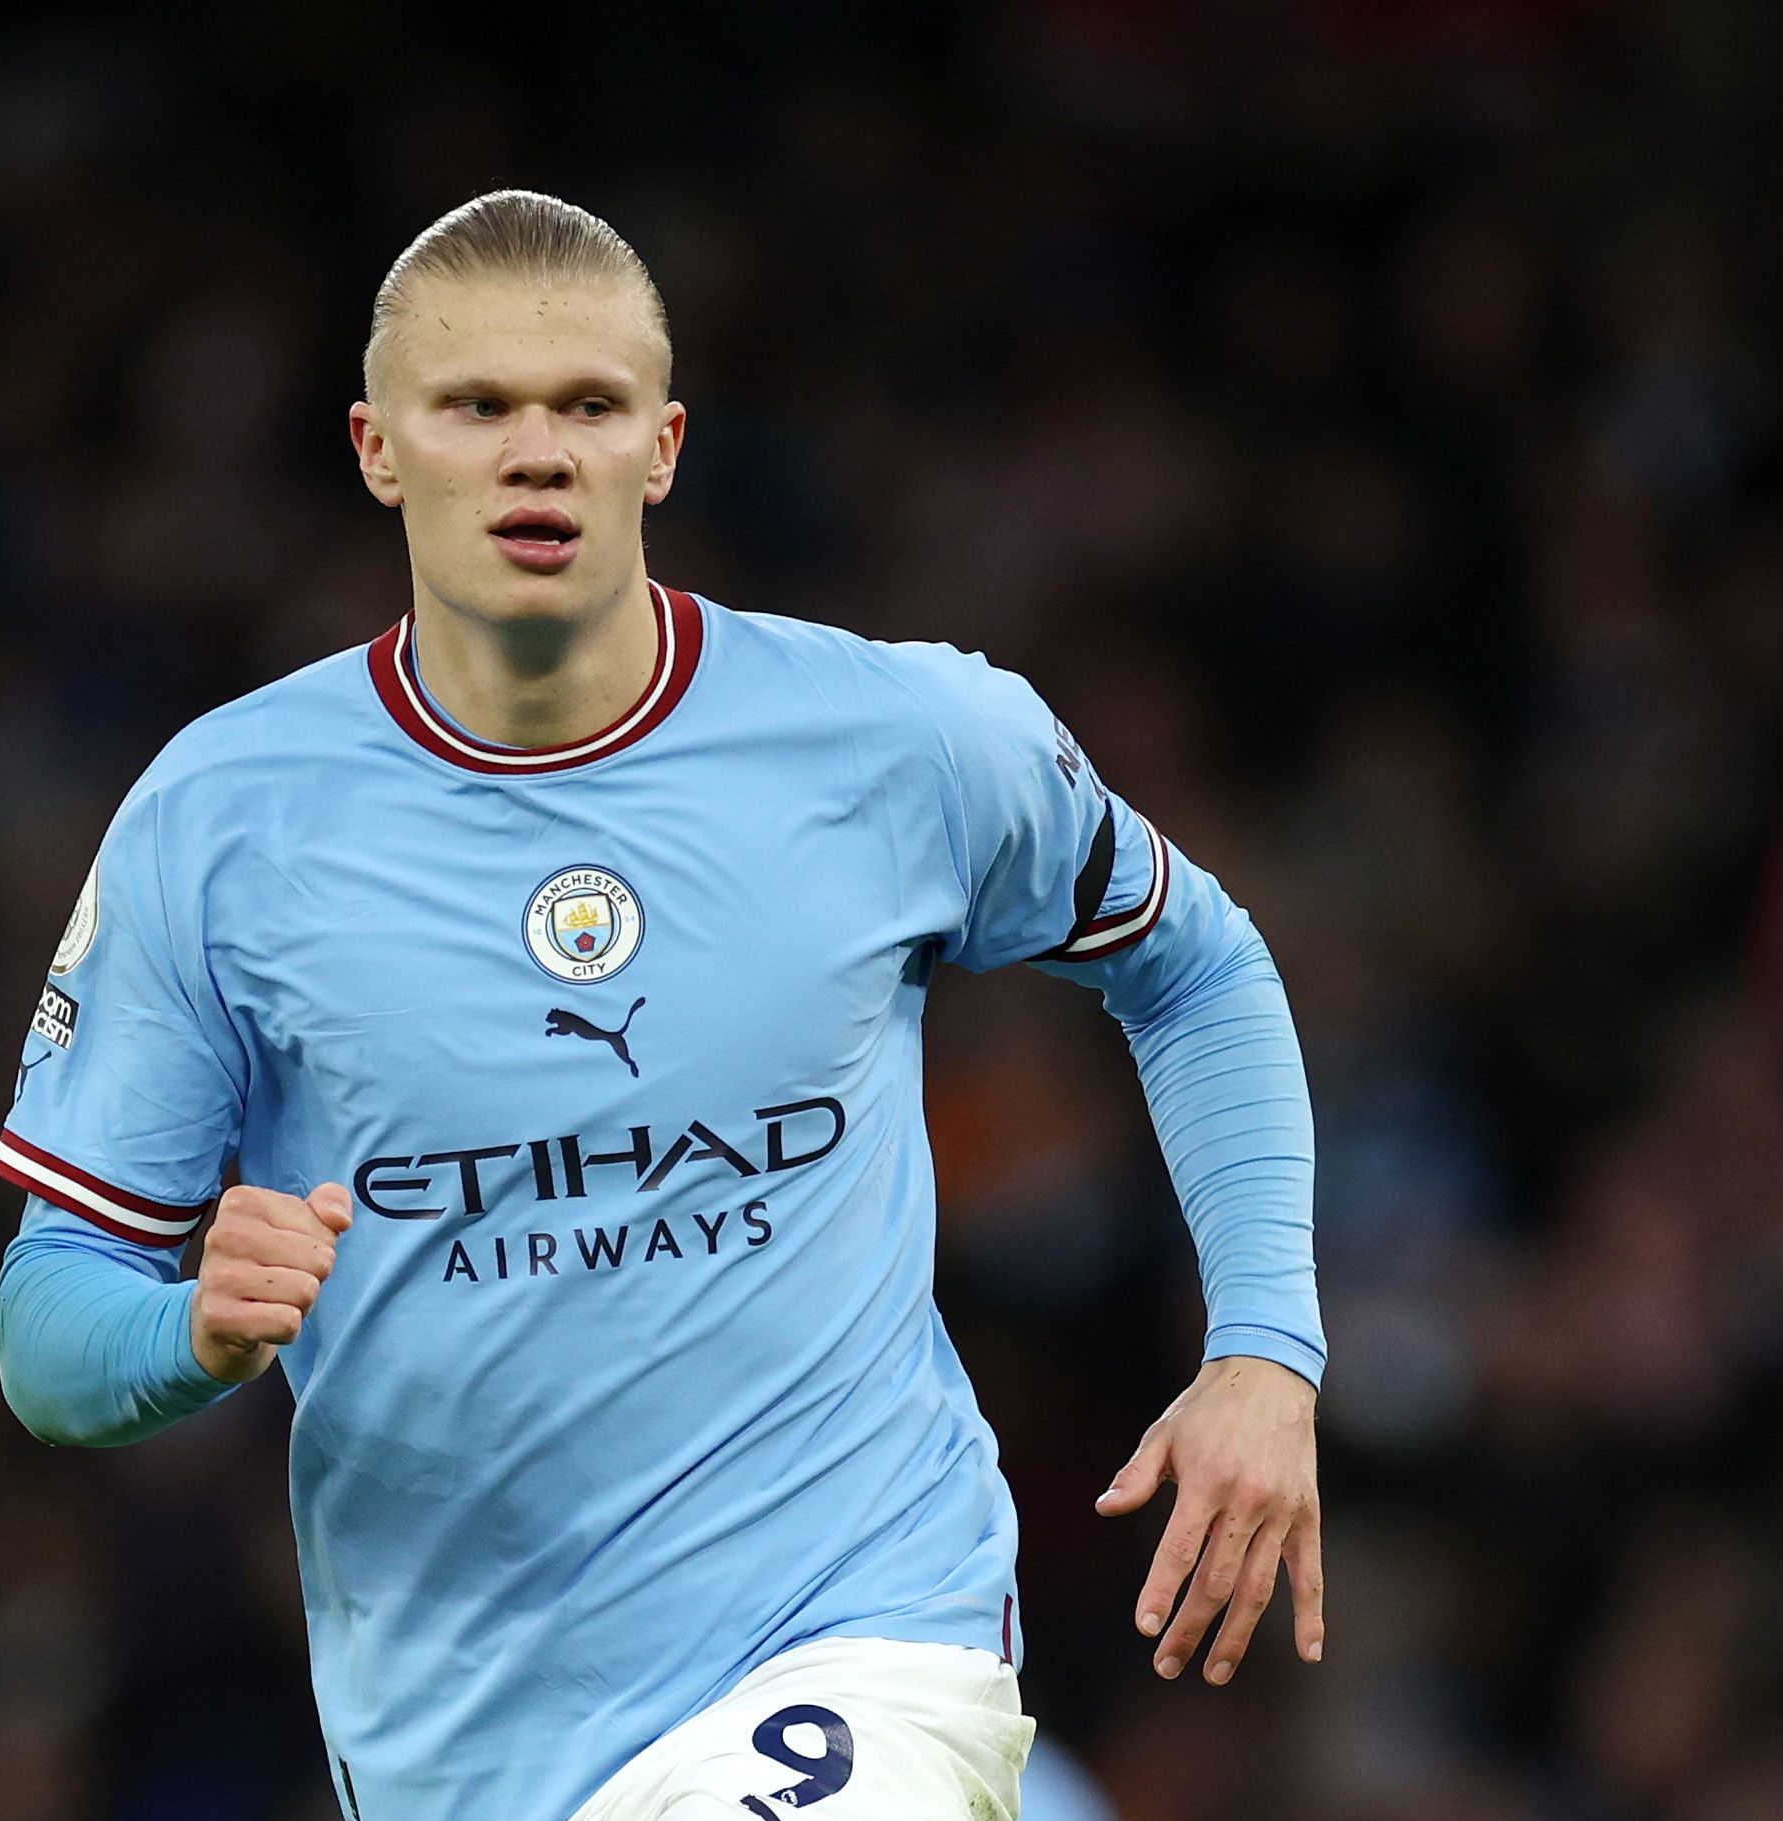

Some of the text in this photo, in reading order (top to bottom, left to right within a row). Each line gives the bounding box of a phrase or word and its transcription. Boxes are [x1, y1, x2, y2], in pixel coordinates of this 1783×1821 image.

[535, 874, 628, 916] MANCHESTER
[572, 962, 606, 977] CITY
[353, 1096, 846, 1220] ETIHAD
[443, 1201, 774, 1283] AIRWAYS
[752, 1704, 854, 1808] 9
